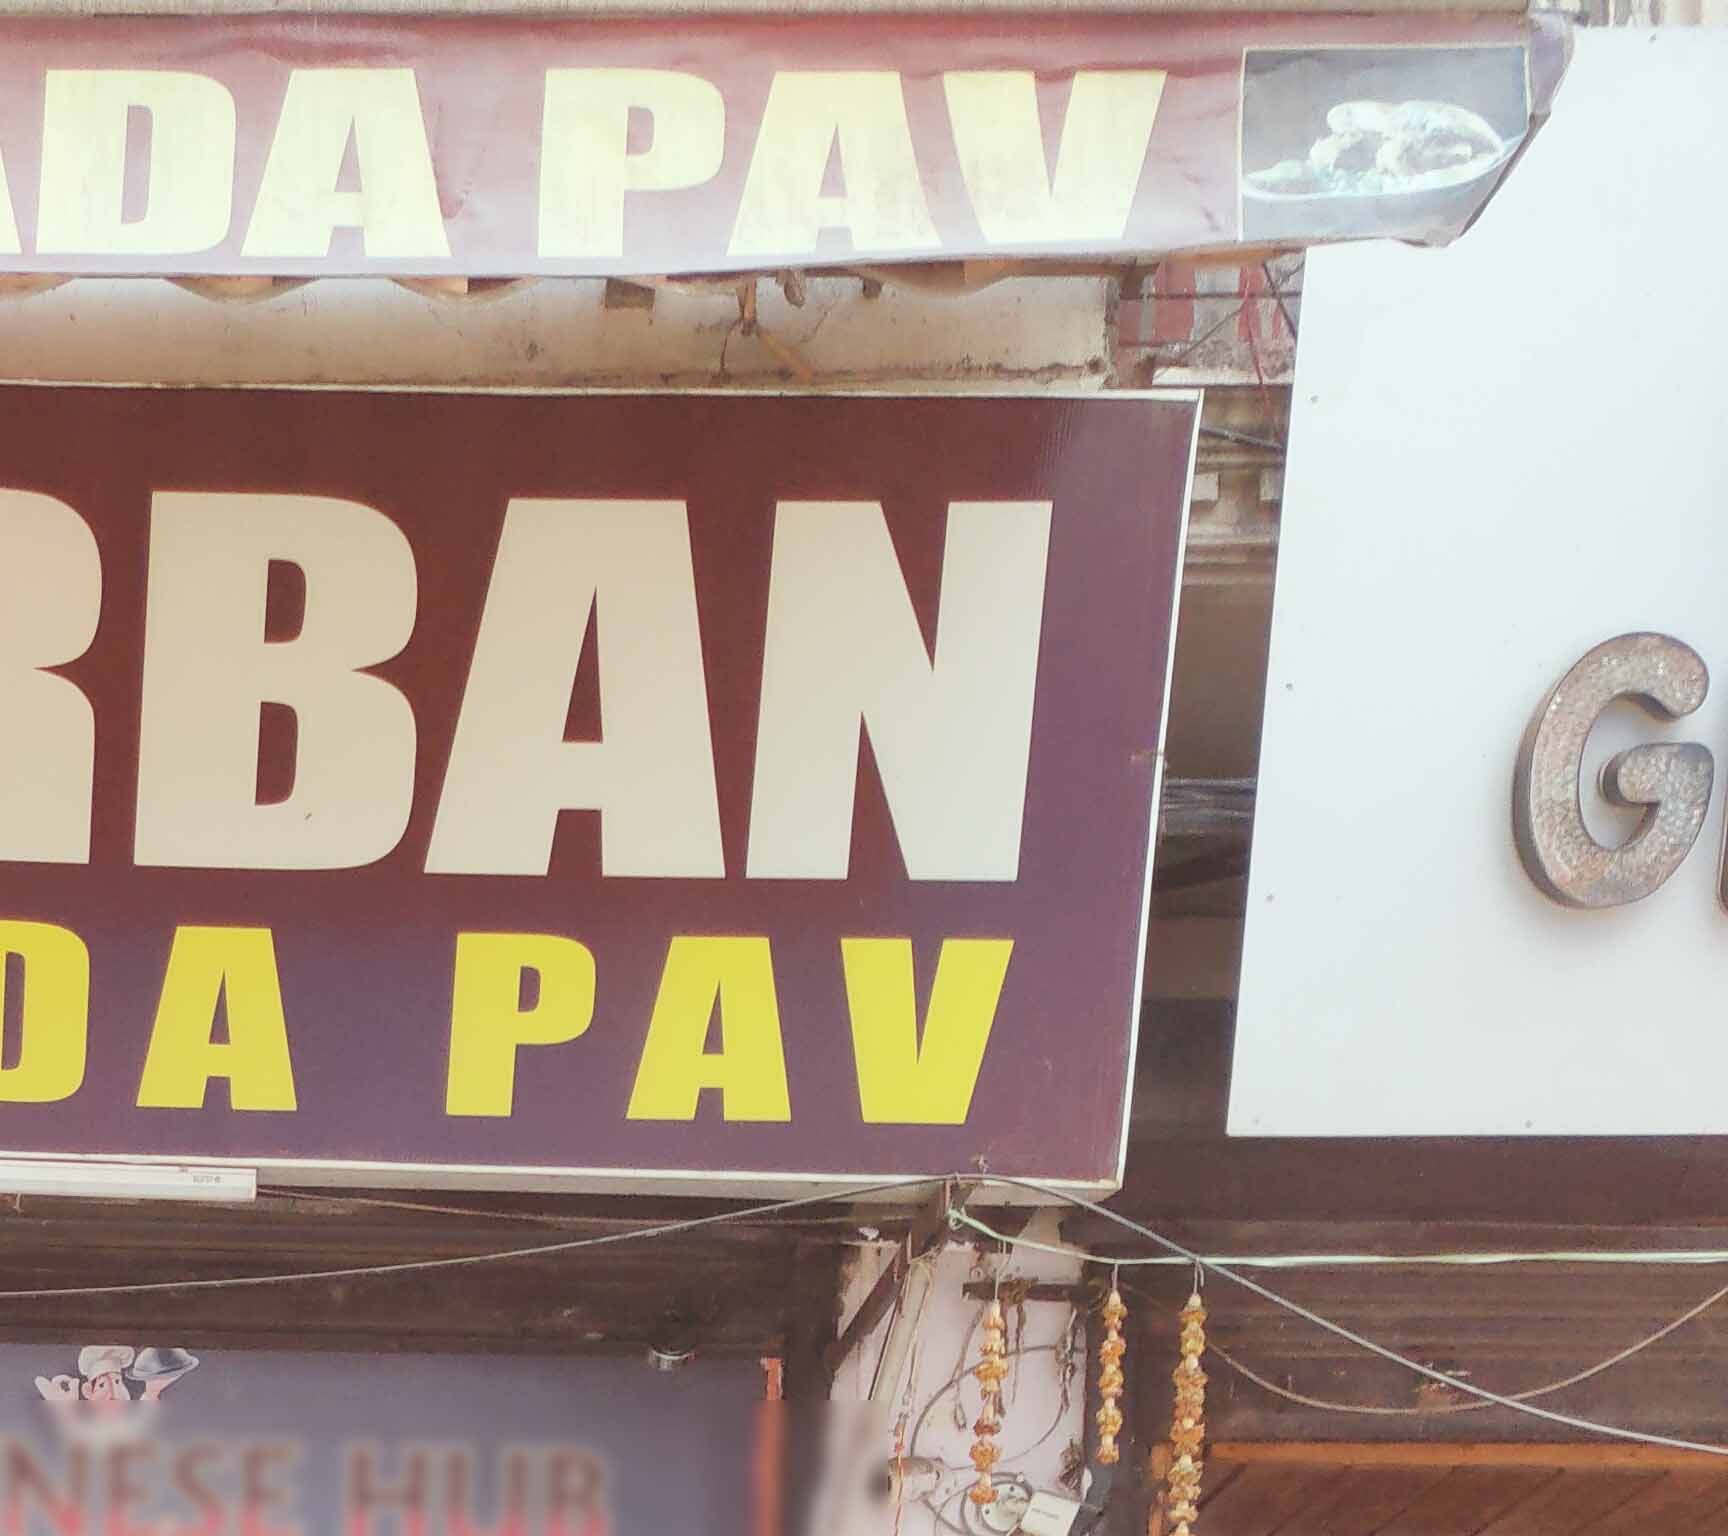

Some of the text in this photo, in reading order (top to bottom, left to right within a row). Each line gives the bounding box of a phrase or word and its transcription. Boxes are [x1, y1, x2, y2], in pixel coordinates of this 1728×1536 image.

[536, 68, 1169, 259] PAV
[1512, 630, 1728, 914] G
[445, 931, 1016, 1124] PAV
